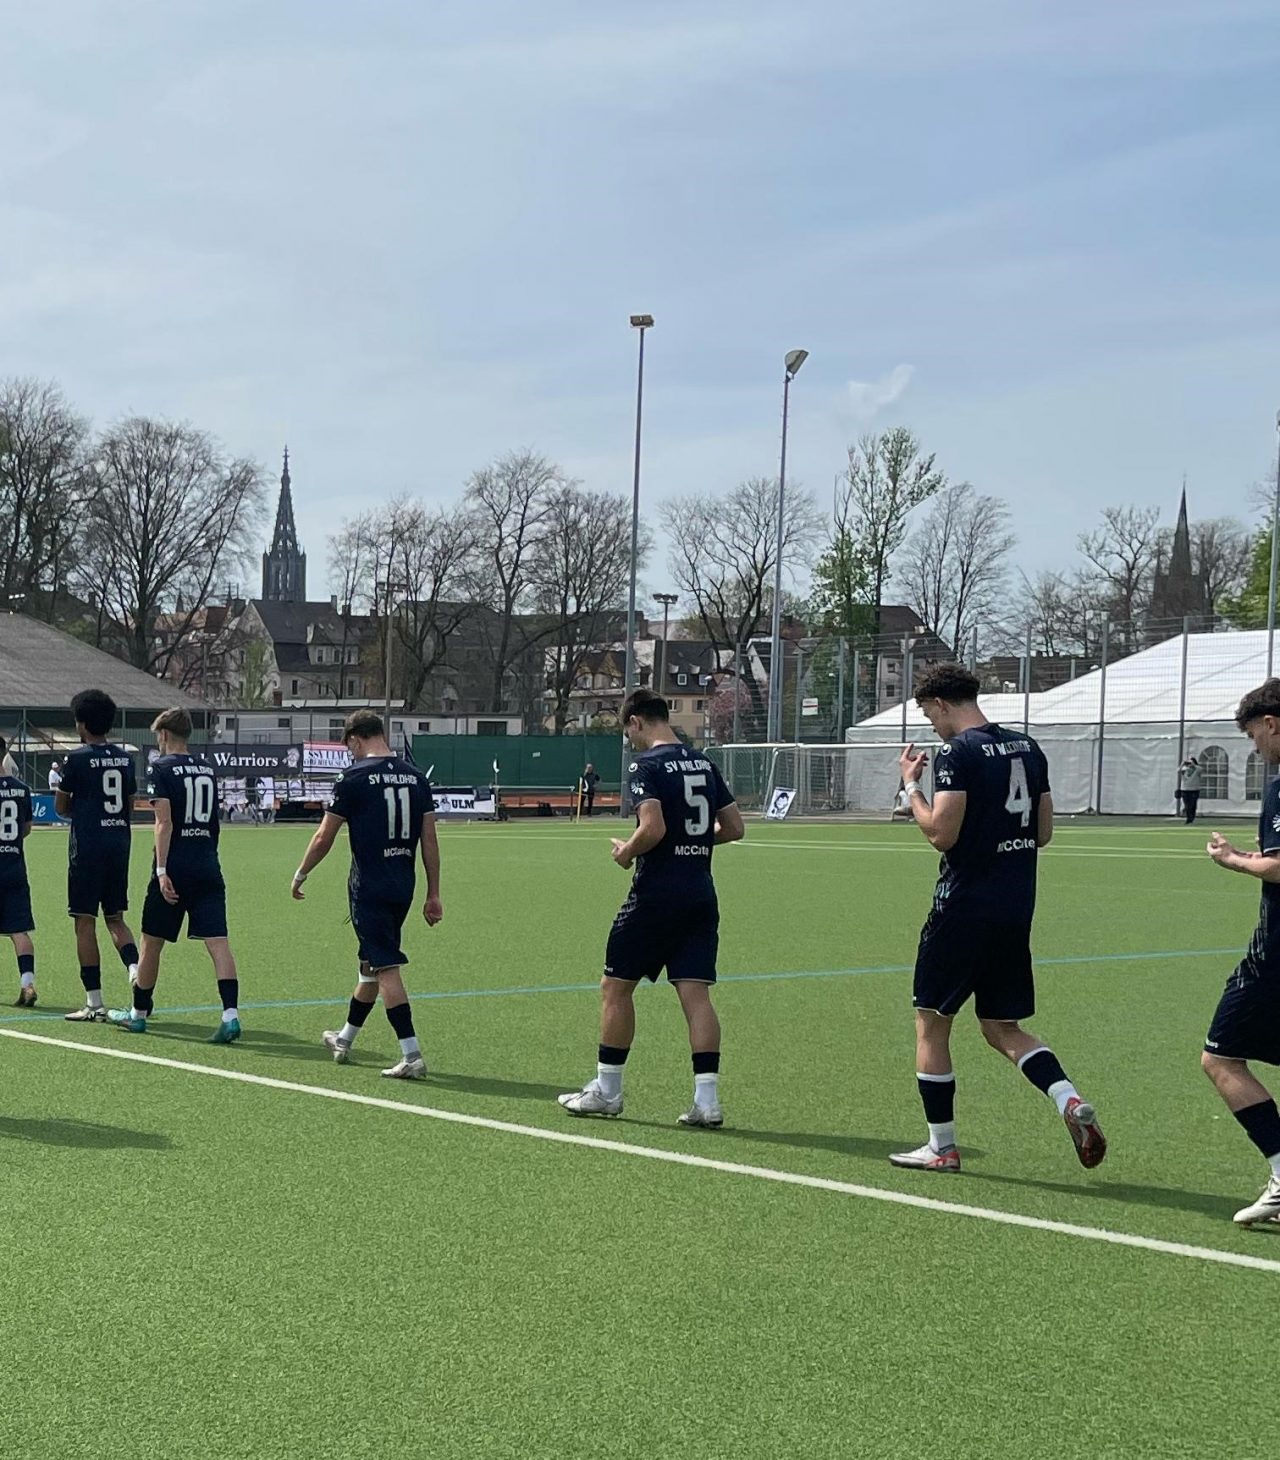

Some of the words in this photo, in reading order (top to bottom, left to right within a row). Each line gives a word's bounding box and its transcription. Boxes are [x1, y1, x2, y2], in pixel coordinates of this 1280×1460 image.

[982, 743, 995, 757] SV
[90, 758, 99, 768] SV
[214, 752, 278, 767] Warriors
[172, 765, 184, 776] SV
[665, 761, 678, 773] SV
[369, 775, 381, 785] SV
[102, 769, 123, 814] 9
[1004, 756, 1032, 828] 4
[183, 776, 214, 824] 10
[451, 800, 475, 809] ULM
[683, 774, 710, 836] 5
[384, 786, 411, 840] 11
